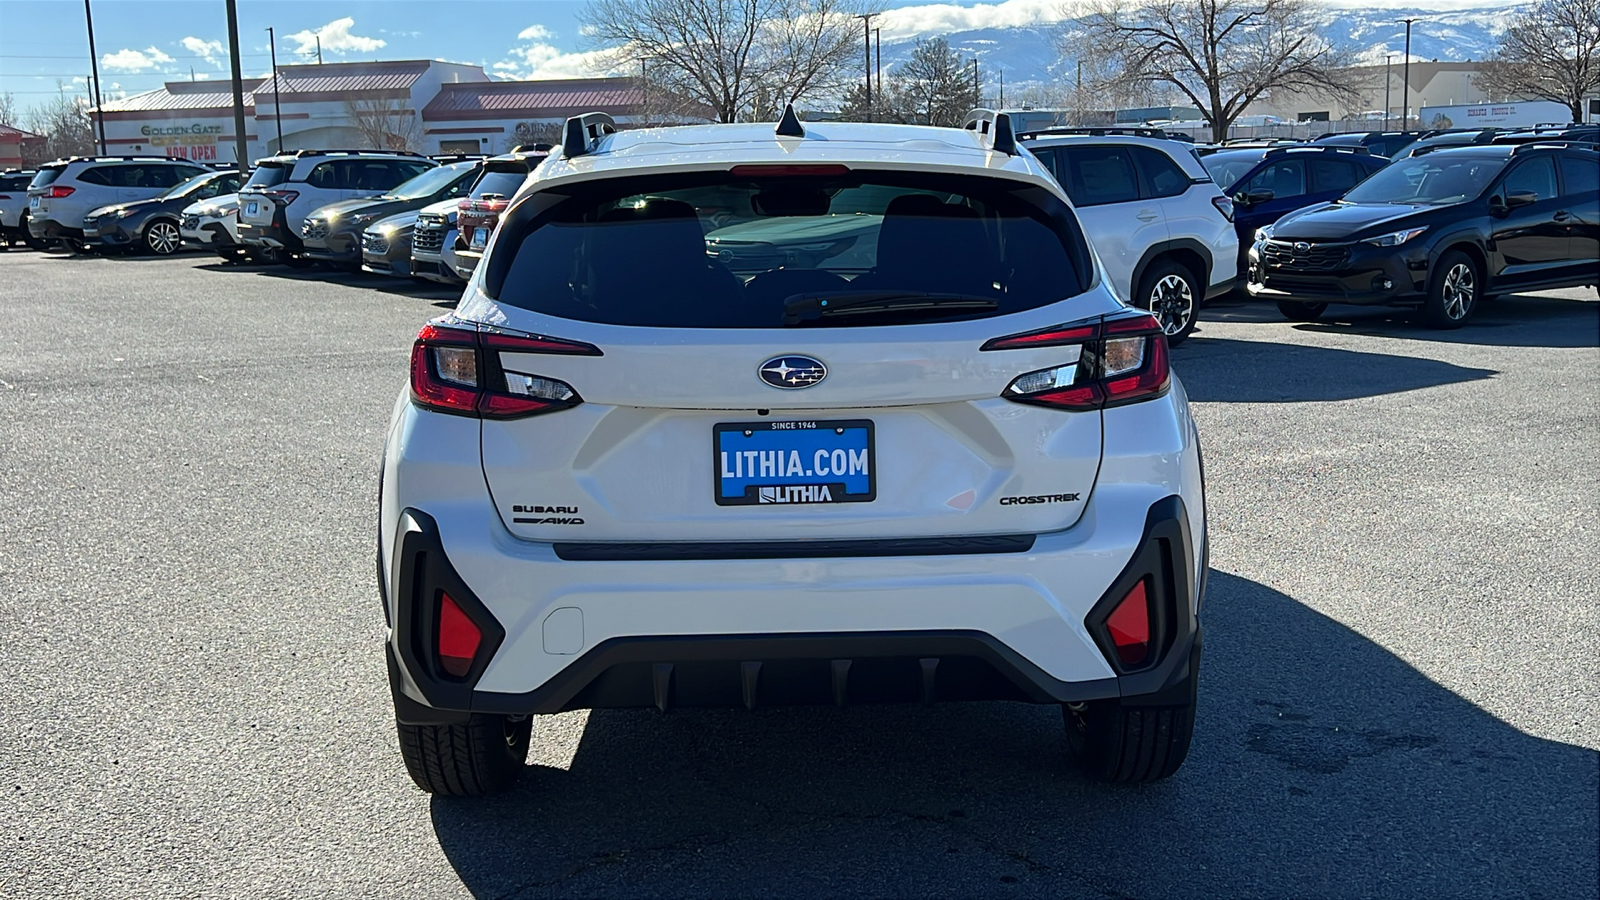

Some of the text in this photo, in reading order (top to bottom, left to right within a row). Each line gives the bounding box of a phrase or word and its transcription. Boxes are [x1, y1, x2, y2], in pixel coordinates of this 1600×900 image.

[141, 123, 221, 136] GOLDEN GATE
[166, 145, 217, 160] NOW OPEN
[771, 421, 817, 430] SINCE 1946
[721, 449, 869, 478] LITHIA.COM
[775, 485, 833, 503] LITHIA
[999, 492, 1081, 506] CROSSTREK
[512, 505, 578, 514] SUBARU
[539, 517, 585, 525] AWD
